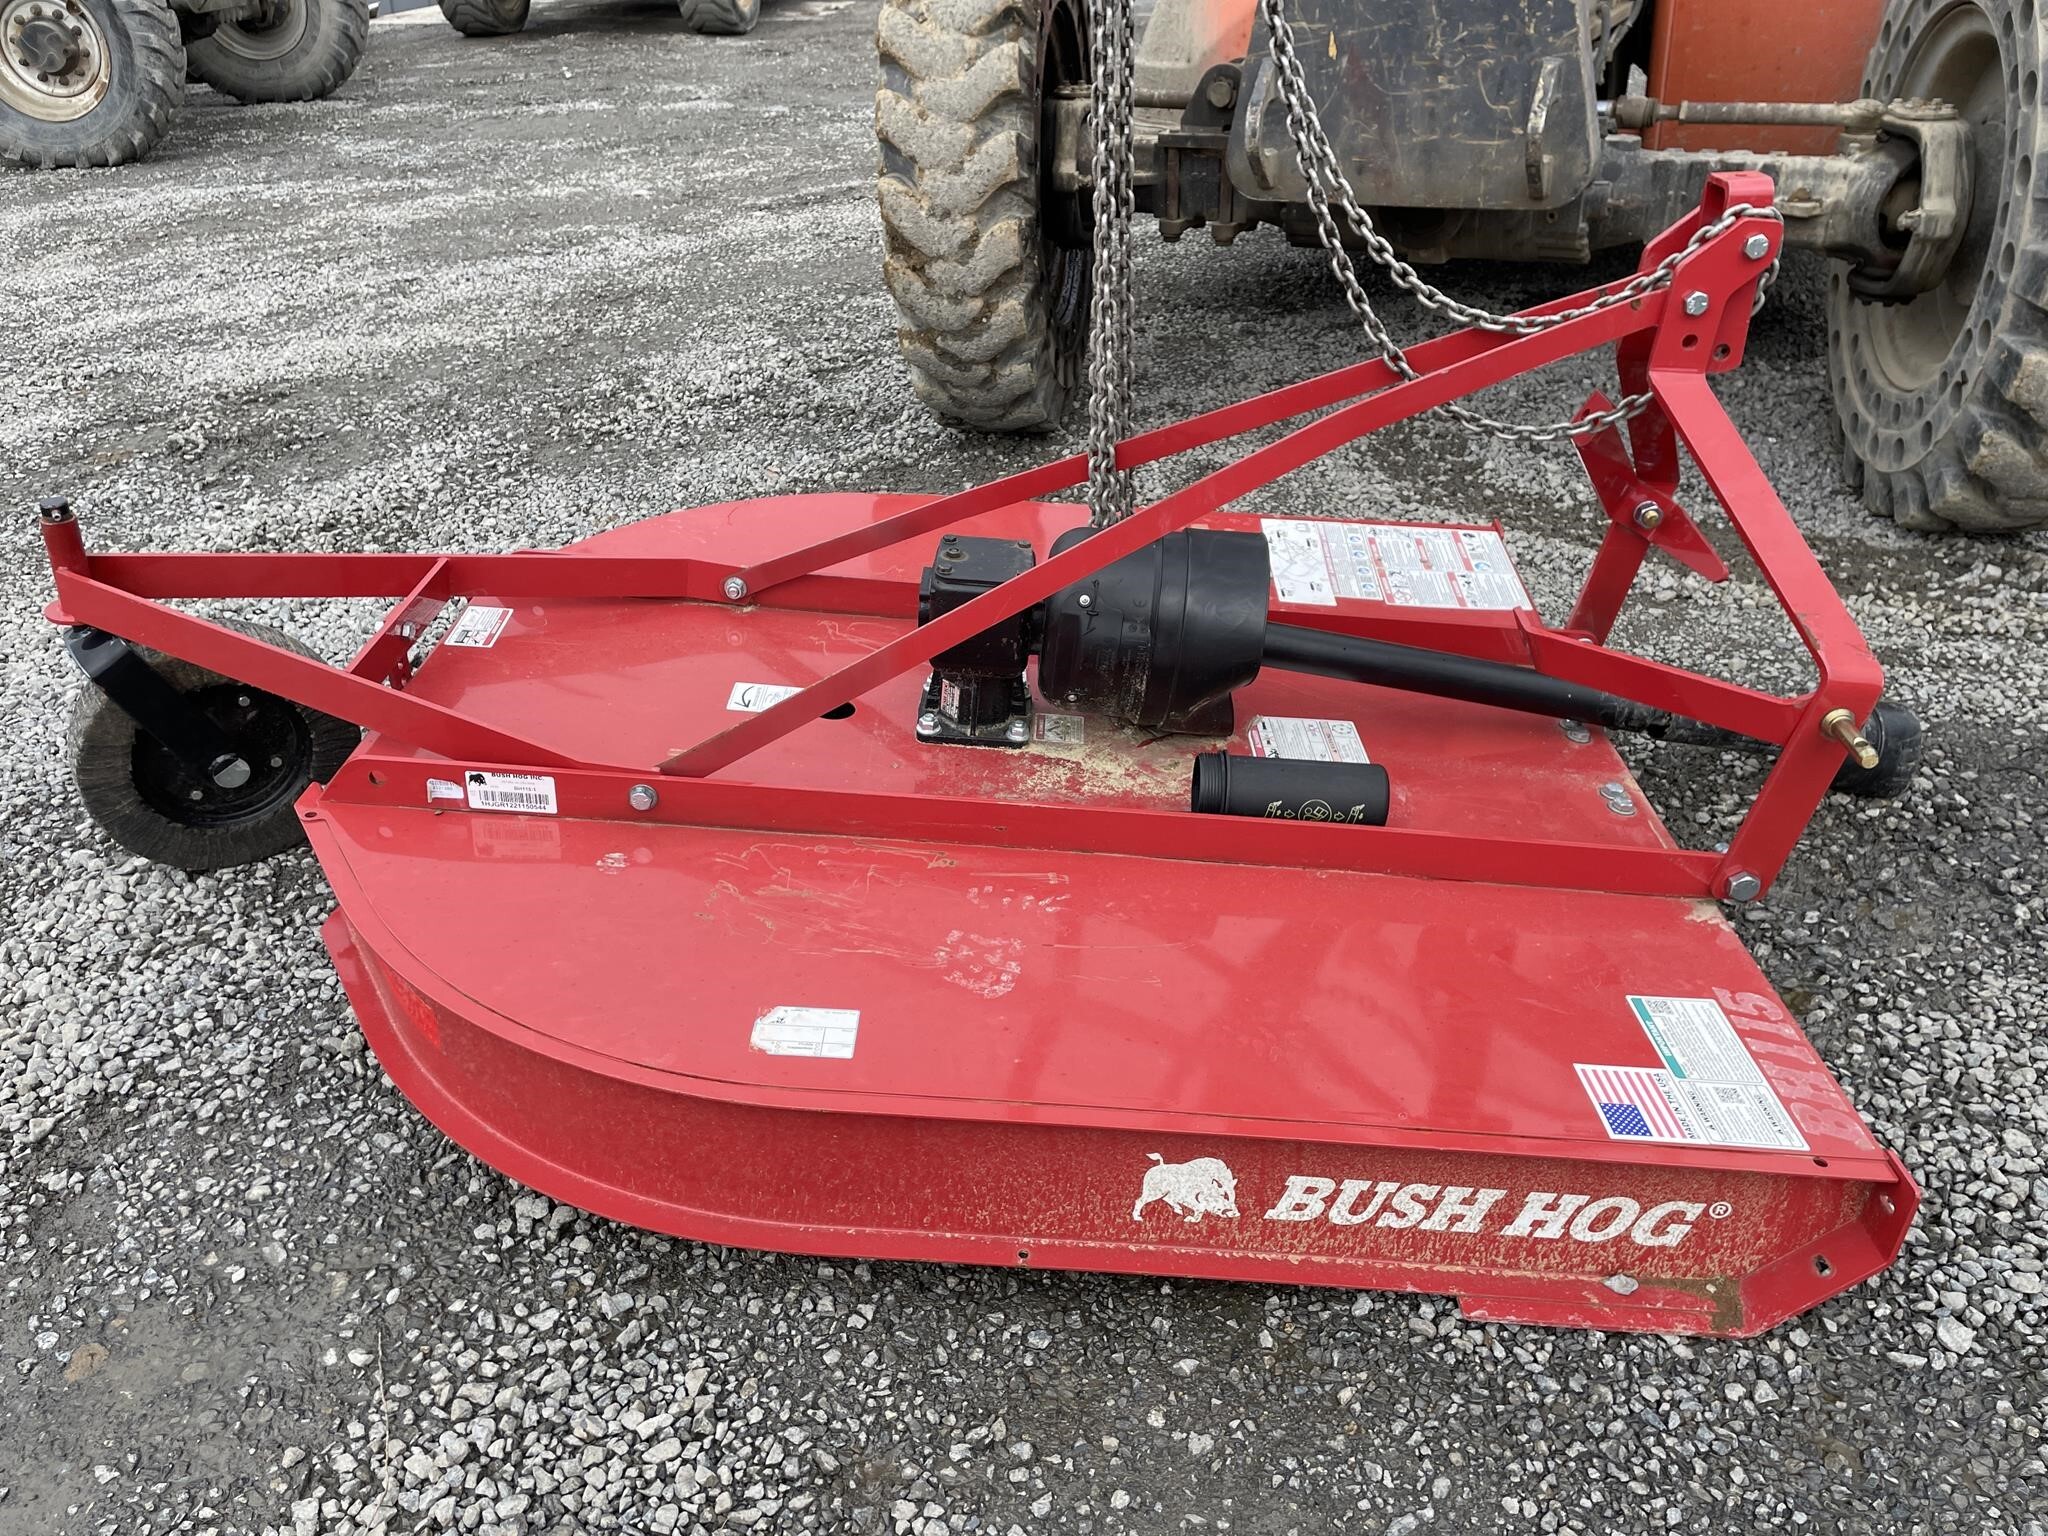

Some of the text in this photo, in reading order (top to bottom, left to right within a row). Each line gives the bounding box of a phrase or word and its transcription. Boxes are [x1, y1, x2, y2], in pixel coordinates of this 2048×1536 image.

[1645, 1020, 1673, 1057] IMPORTANT
[1711, 986, 1876, 1151] BH115
[1653, 1073, 1697, 1139] MADE IN THE USA
[1687, 1090, 1710, 1123] WARNING
[1263, 1174, 1507, 1233] BUSH
